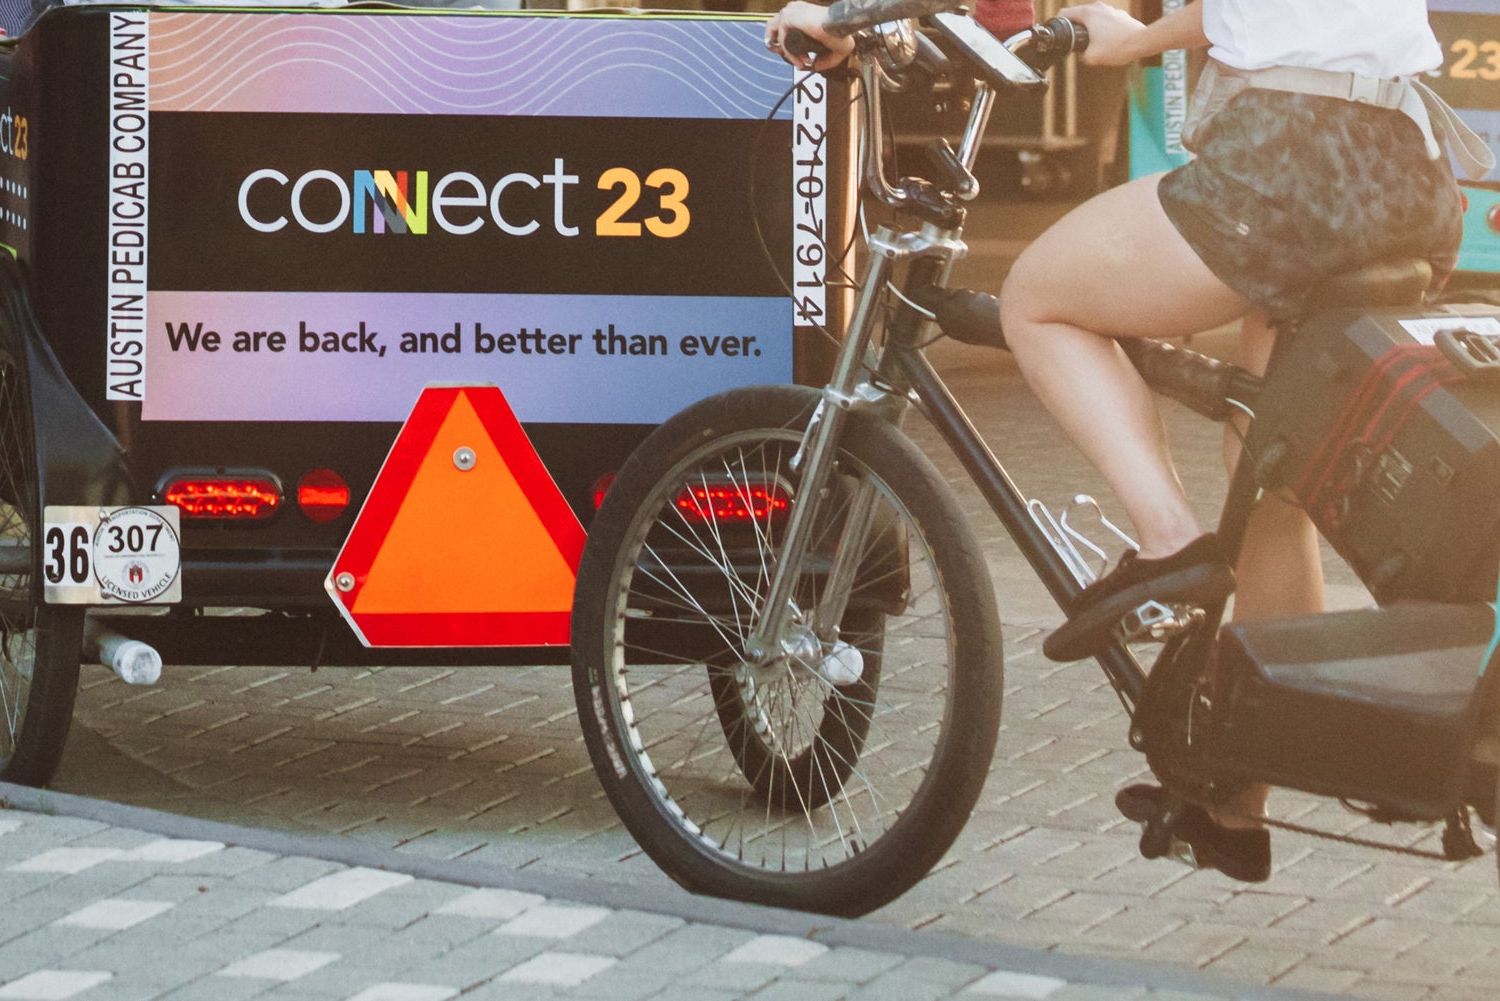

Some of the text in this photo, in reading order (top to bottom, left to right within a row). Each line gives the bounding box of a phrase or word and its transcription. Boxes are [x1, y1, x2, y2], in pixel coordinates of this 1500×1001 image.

[1165, 49, 1183, 91] PEDIC
[14, 114, 29, 161] 23
[1165, 92, 1184, 155] AUSTIN
[109, 15, 147, 398] AUSTIN PEDICAB COMPANY
[595, 166, 691, 238] 23
[165, 322, 762, 358] We are back, and better than ever.
[45, 526, 90, 584] 36
[107, 524, 164, 553] 307
[101, 575, 139, 599] LICENSED
[140, 571, 173, 599] VEHICLE
